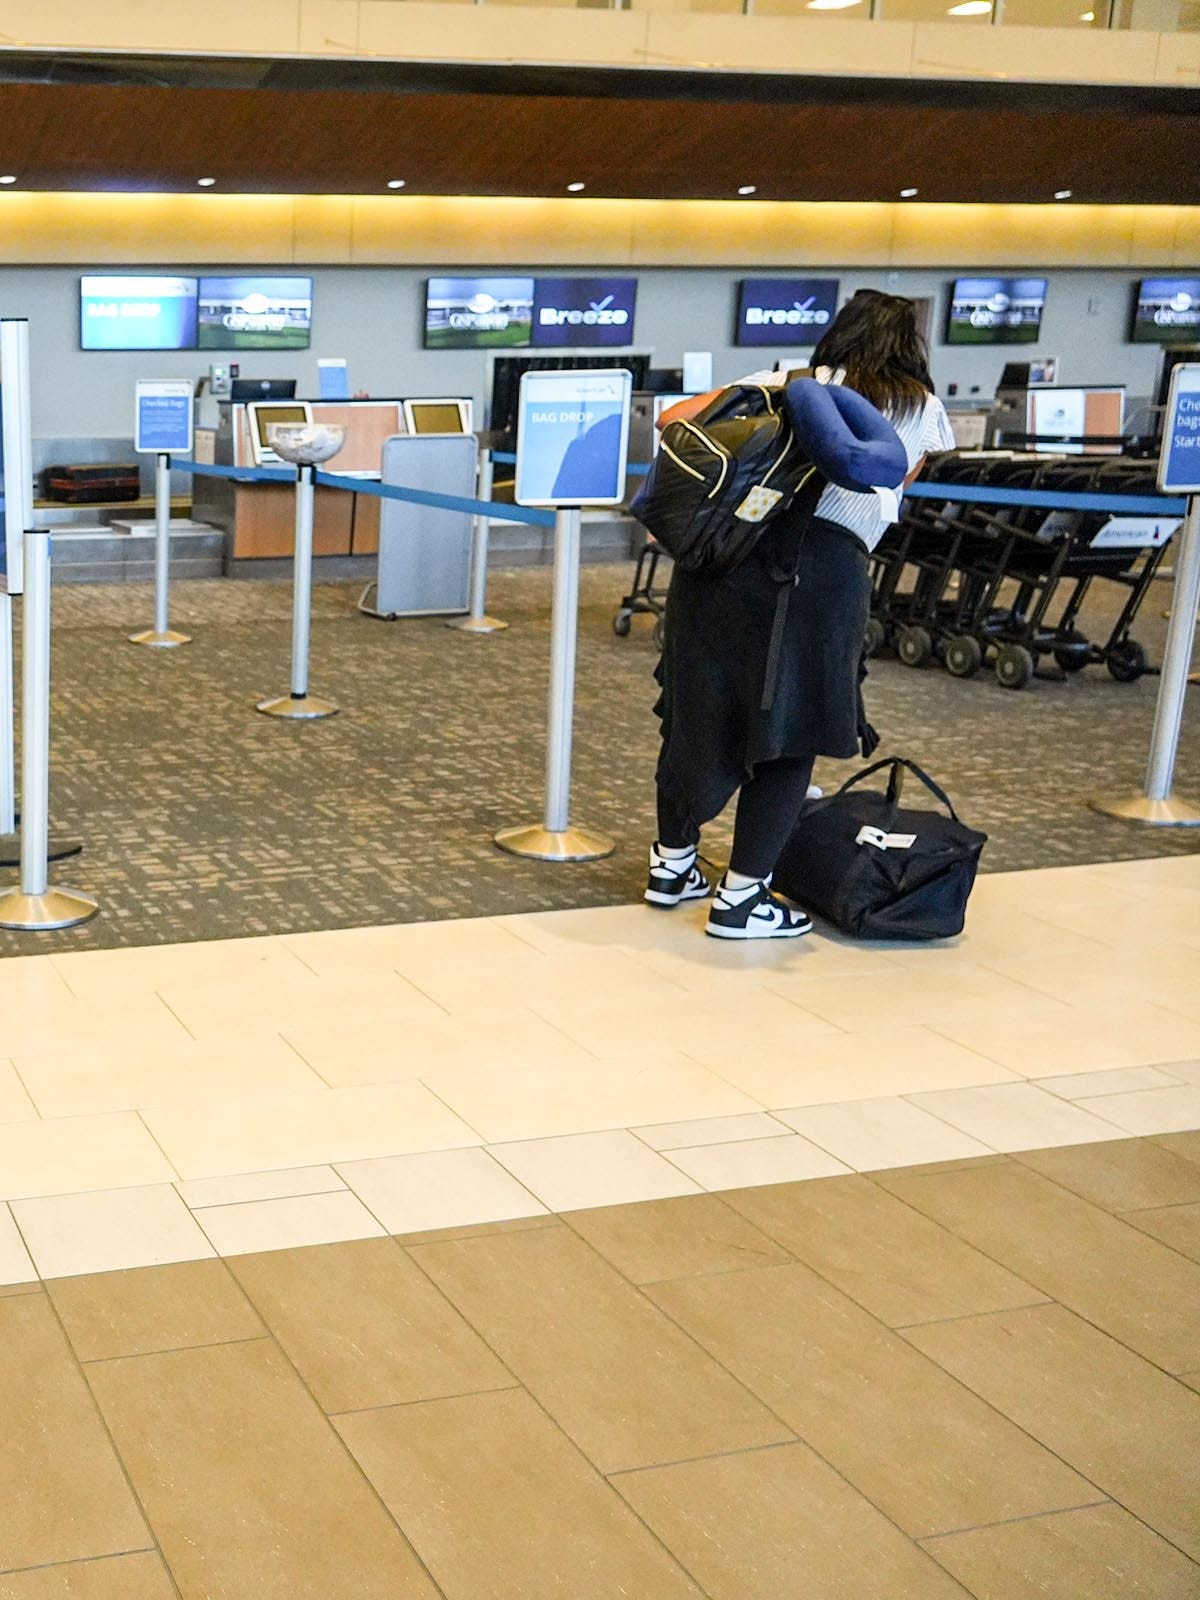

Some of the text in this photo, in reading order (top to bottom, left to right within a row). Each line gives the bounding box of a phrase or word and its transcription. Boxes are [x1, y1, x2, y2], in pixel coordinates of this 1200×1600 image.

[539, 307, 629, 326] Breeze
[745, 307, 830, 325] Breeze
[531, 412, 593, 424] BAG DROP
